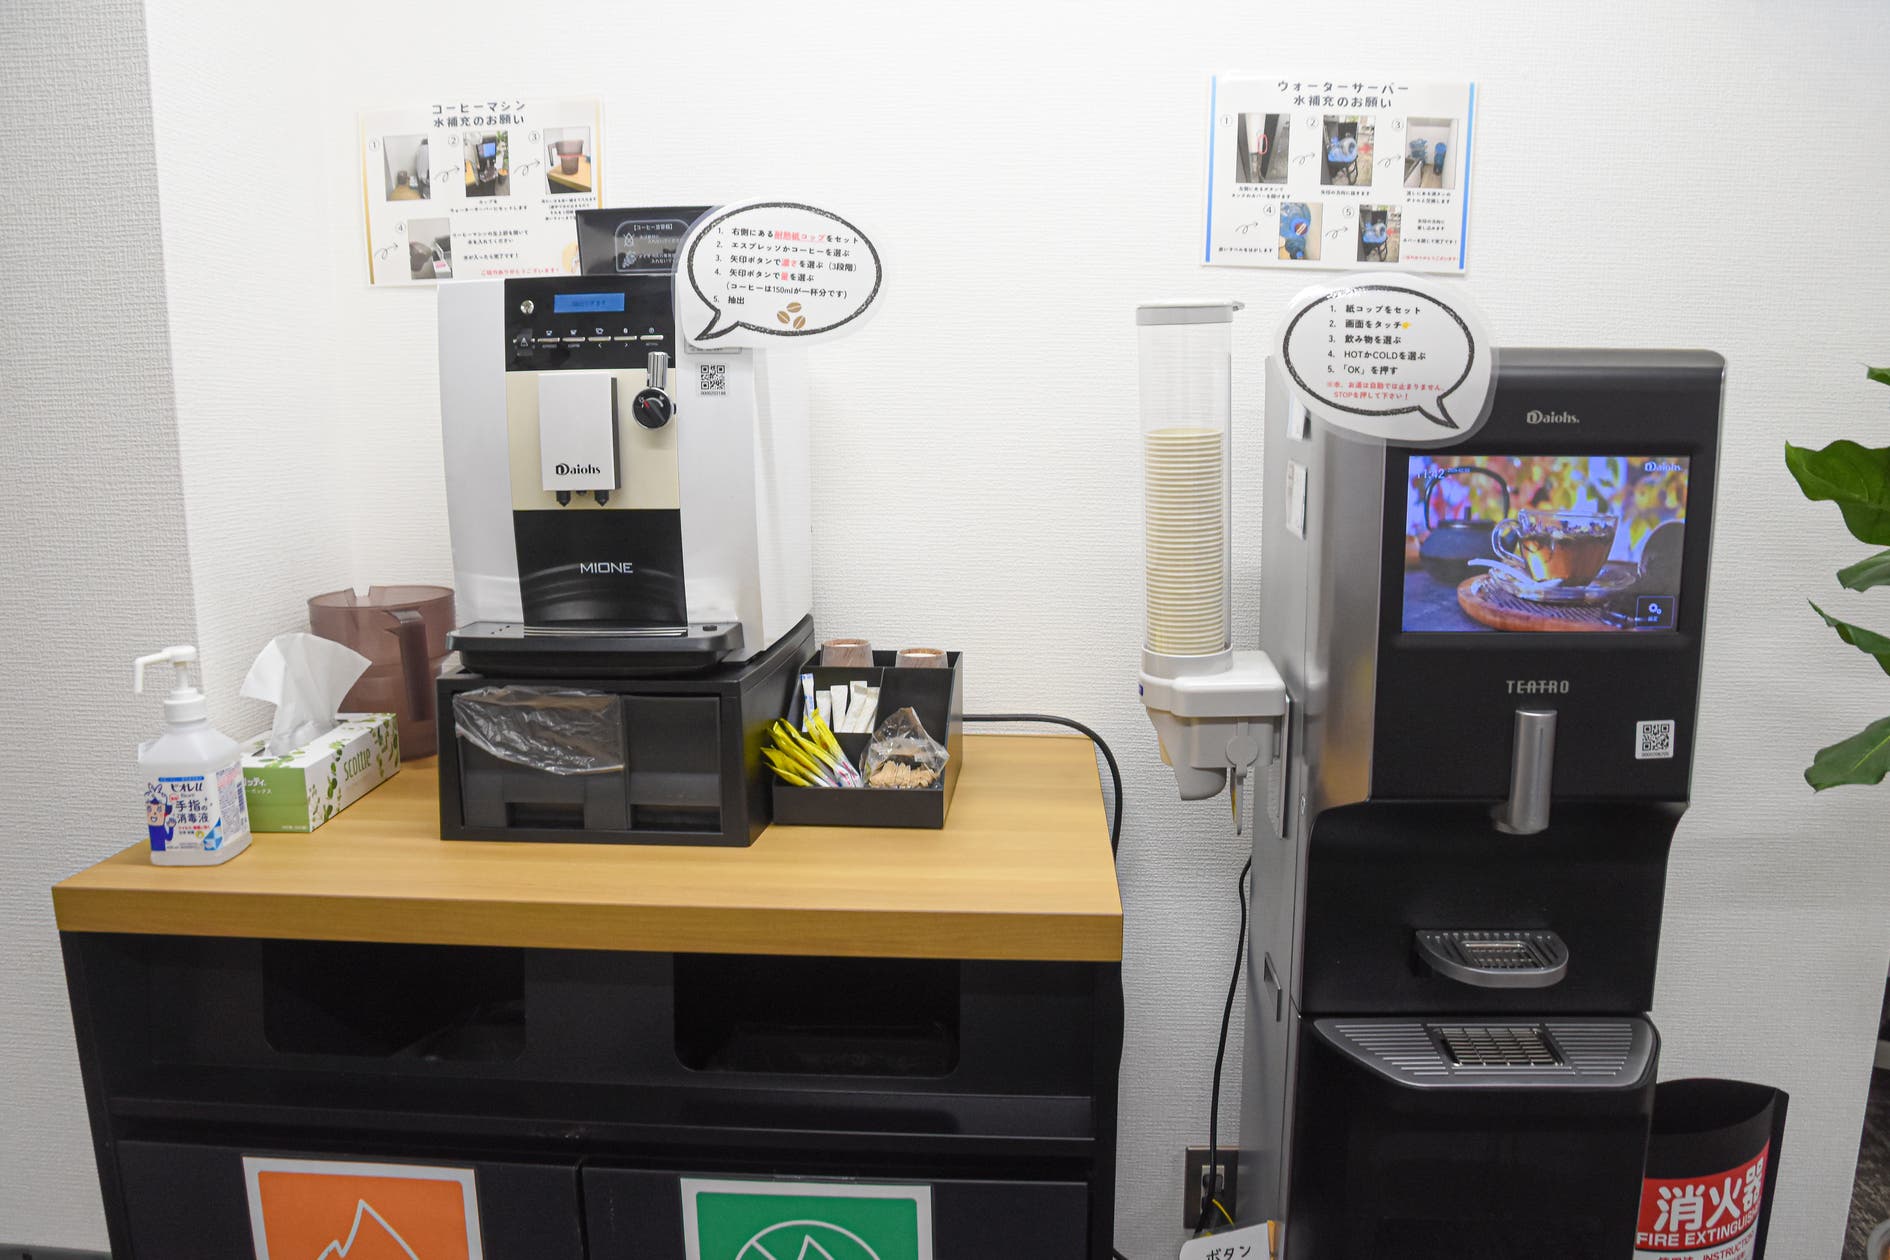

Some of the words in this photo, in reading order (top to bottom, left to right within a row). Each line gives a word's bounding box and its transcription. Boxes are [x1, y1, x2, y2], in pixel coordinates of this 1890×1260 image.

[1278, 80, 1408, 95] ウォーターサーバー
[432, 100, 526, 115] コーヒーマシン
[1293, 94, 1392, 108] 水補充のお願い
[433, 113, 526, 128] 水補充のお願い
[731, 242, 850, 257] エスプレッソかコーヒーを選ぶ
[728, 296, 745, 305] 抽出
[1330, 305, 1337, 313] 1.
[1345, 304, 1421, 315] 紙コップをセット
[1329, 320, 1336, 328] 2.
[1345, 319, 1402, 329] 画面をタッチ
[1329, 335, 1336, 343] 3.
[1345, 334, 1402, 345] 飲み物を選ぶ
[1328, 350, 1335, 358] 4.
[1344, 350, 1427, 361] HOTかCOLDを選ぶ
[1327, 365, 1335, 373] 5.
[555, 463, 601, 475] Daiohs
[580, 562, 633, 573] MIONE
[1506, 680, 1570, 694] TEATRO
[175, 799, 208, 812] 手指の
[177, 812, 209, 824] 消毒液
[1654, 1157, 1764, 1232] 消火器
[1636, 1231, 1680, 1247] FIRE
[1206, 1245, 1252, 1260] ボタン
